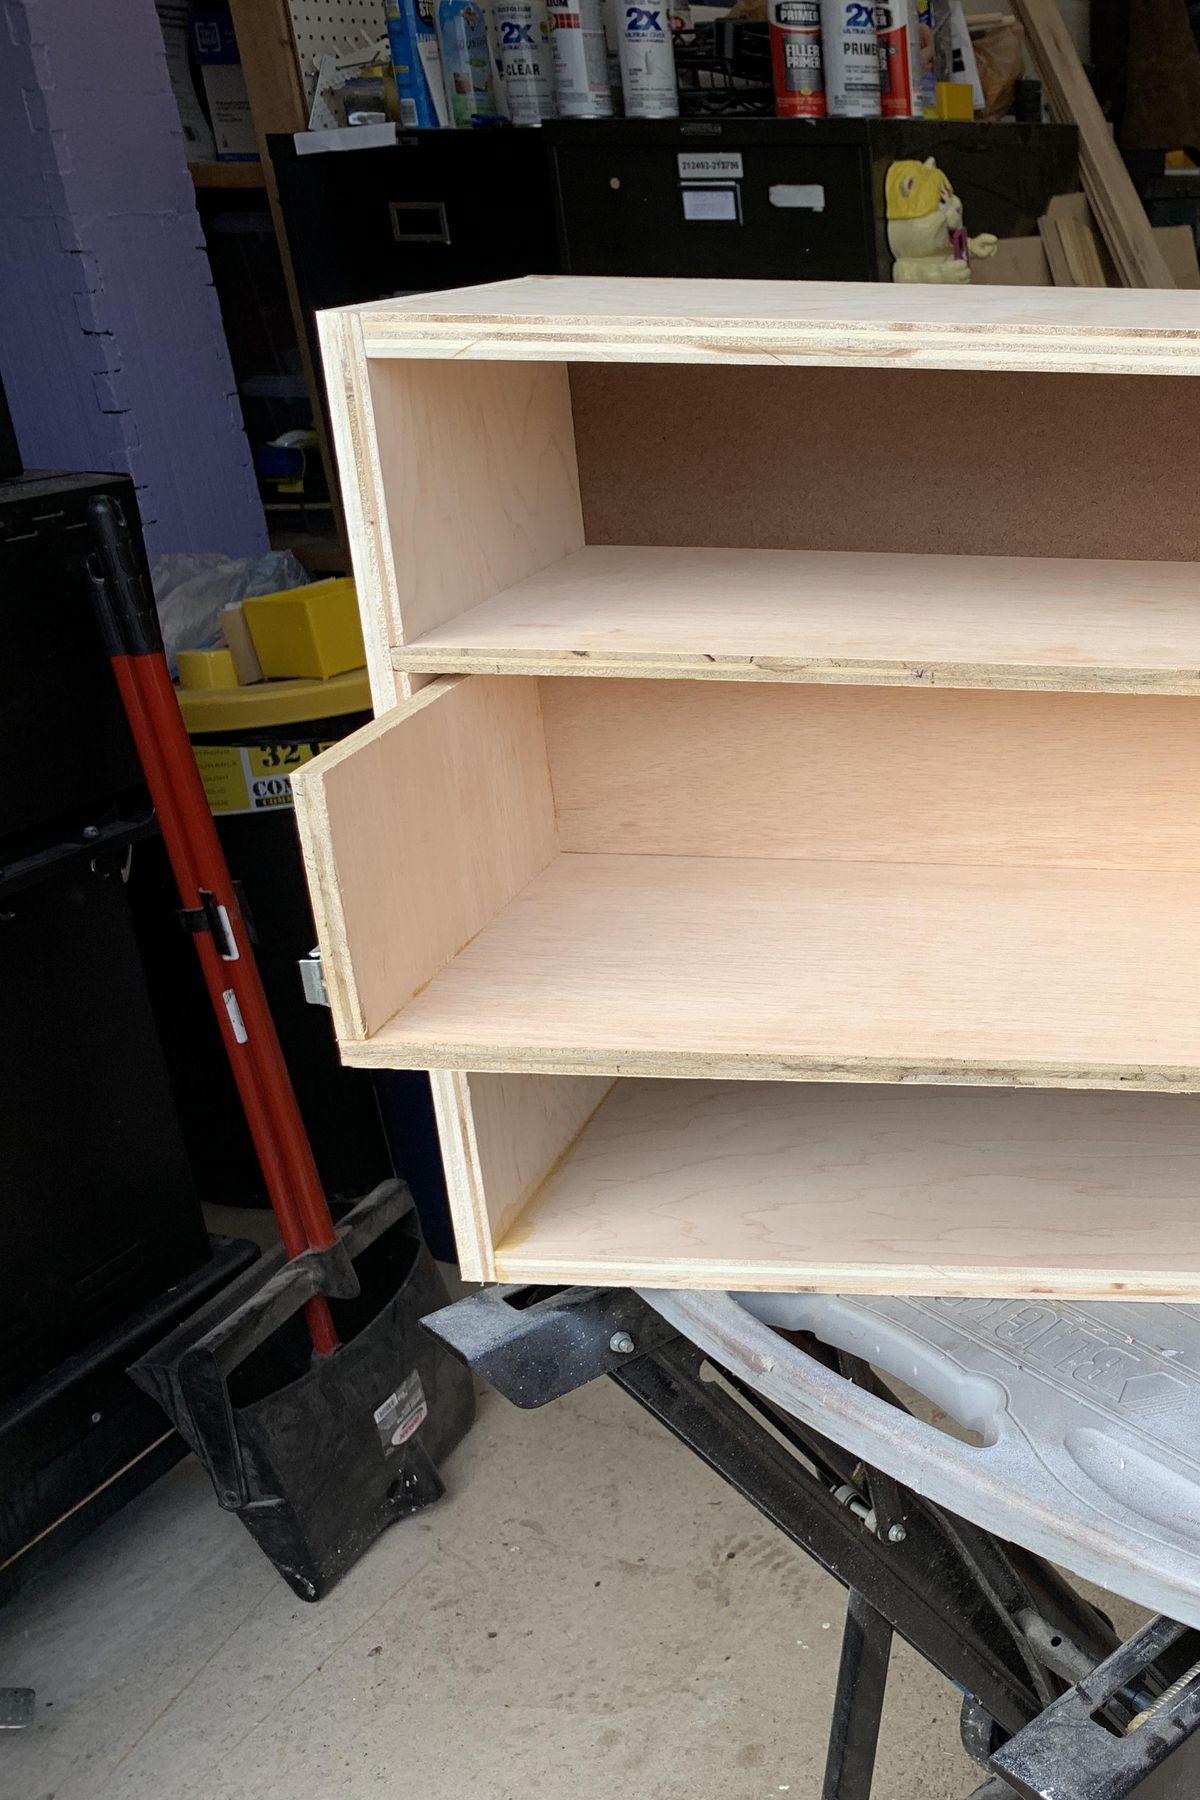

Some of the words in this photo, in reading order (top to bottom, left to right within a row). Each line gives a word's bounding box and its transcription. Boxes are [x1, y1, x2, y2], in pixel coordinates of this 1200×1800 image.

[626, 7, 662, 31] 2X
[780, 10, 820, 22] PRIMER
[846, 3, 875, 27] 2X
[501, 22, 535, 44] 2X
[785, 44, 820, 57] FILLER
[843, 42, 877, 55] PRIME
[786, 56, 821, 69] PRIMER
[506, 63, 540, 76] CLEAR
[260, 744, 302, 767] 32
